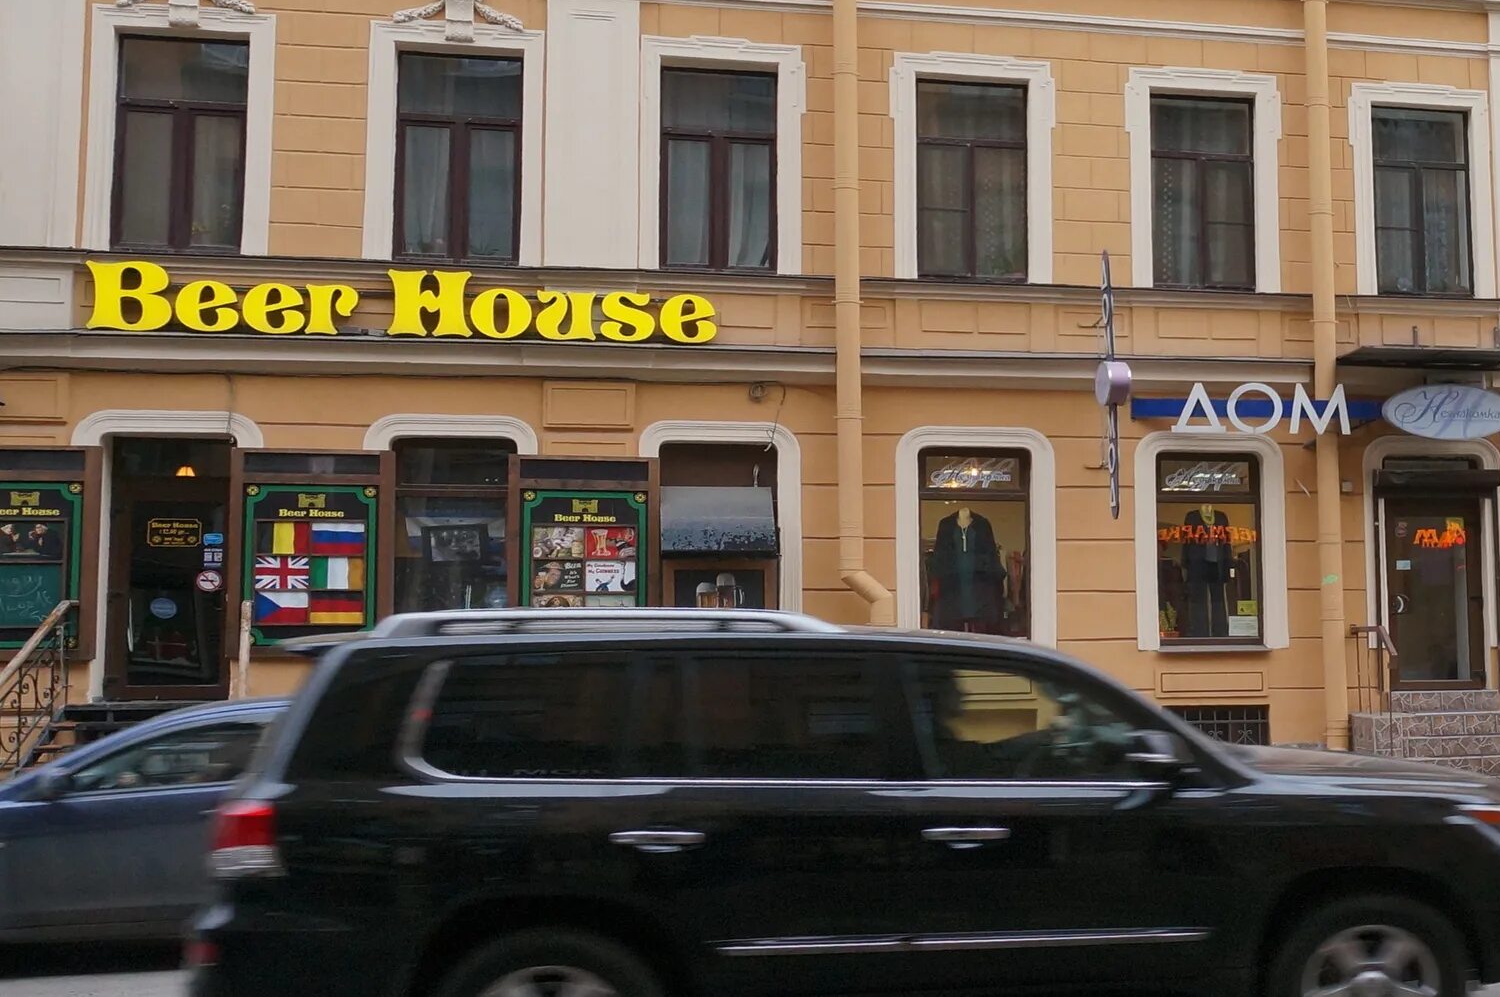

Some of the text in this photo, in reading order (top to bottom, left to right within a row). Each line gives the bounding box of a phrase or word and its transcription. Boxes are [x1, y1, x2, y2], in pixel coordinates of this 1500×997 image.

[85, 260, 719, 343] Beer House
[1171, 382, 1351, 435] ДОМ
[0, 507, 60, 516] eer House
[279, 508, 344, 517] Beer House
[554, 514, 616, 522] Beer House
